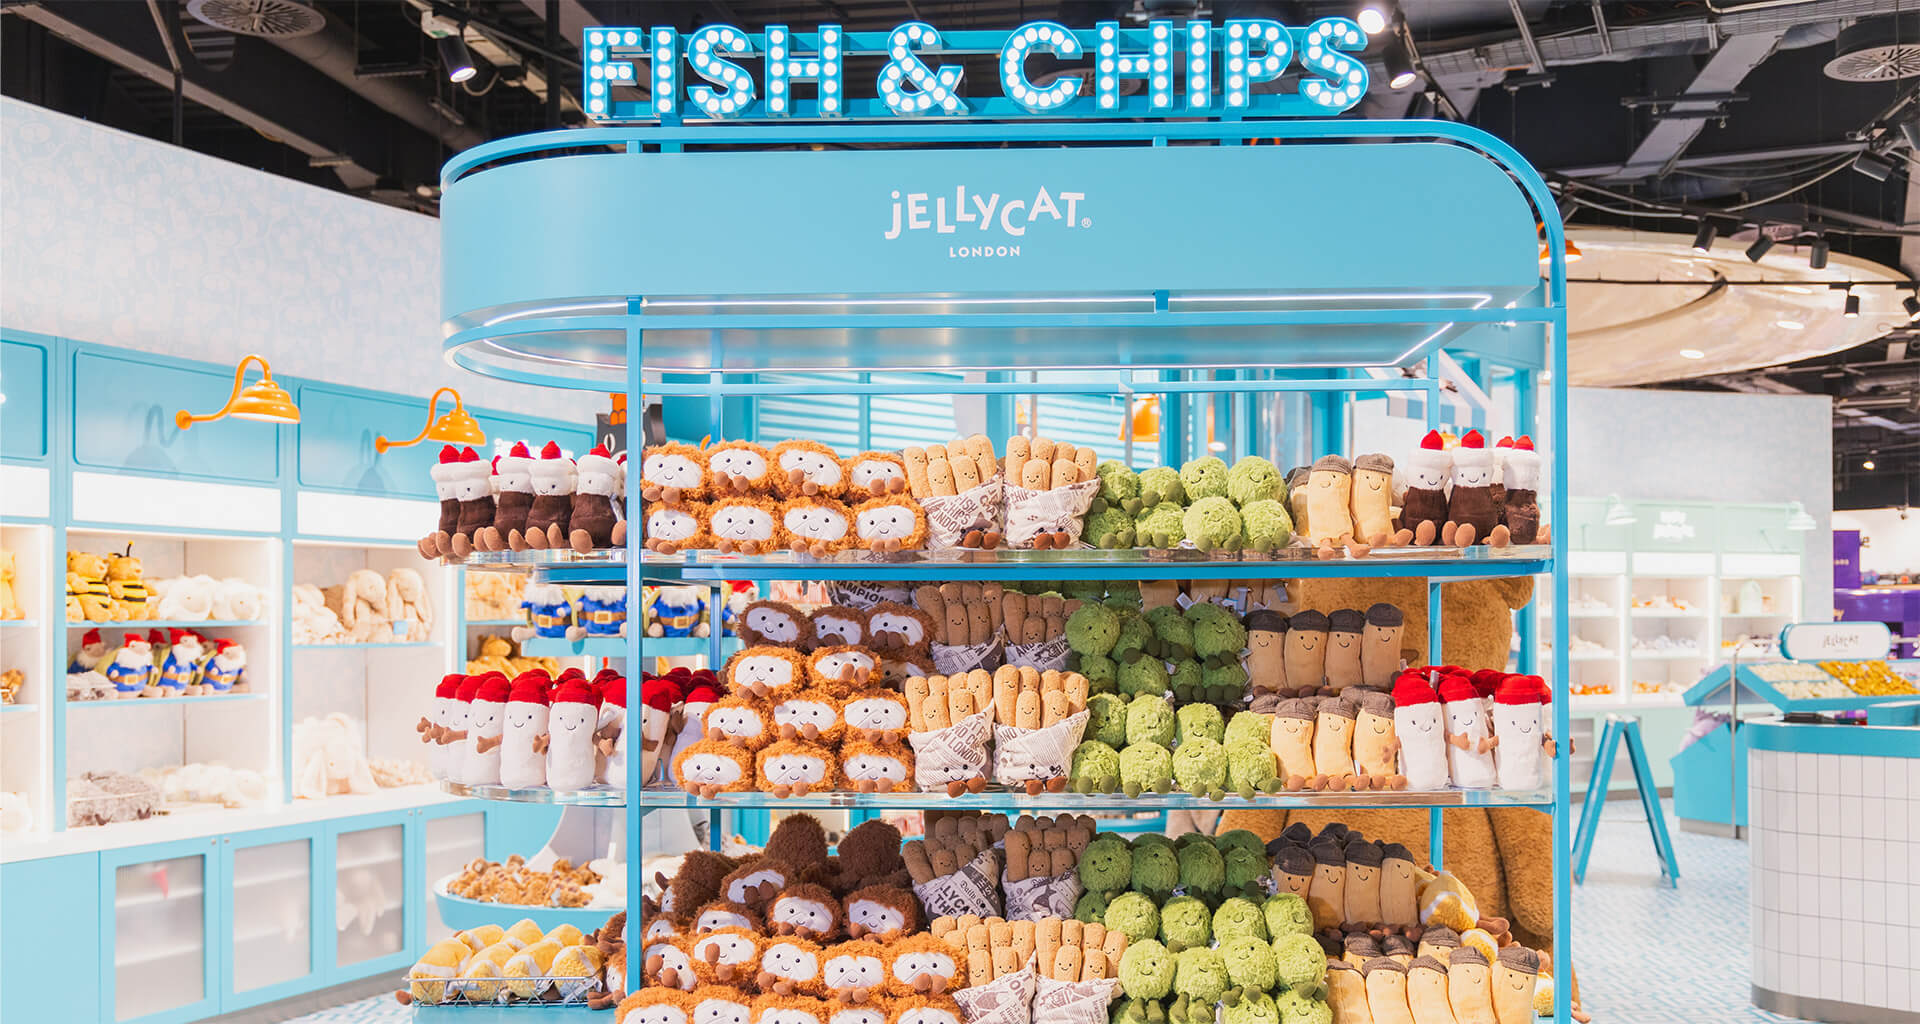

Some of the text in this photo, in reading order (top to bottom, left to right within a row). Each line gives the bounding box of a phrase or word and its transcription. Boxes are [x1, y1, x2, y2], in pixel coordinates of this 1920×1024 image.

[583, 17, 1370, 117] FISH & CHIPS
[949, 246, 1020, 258] LONDON
